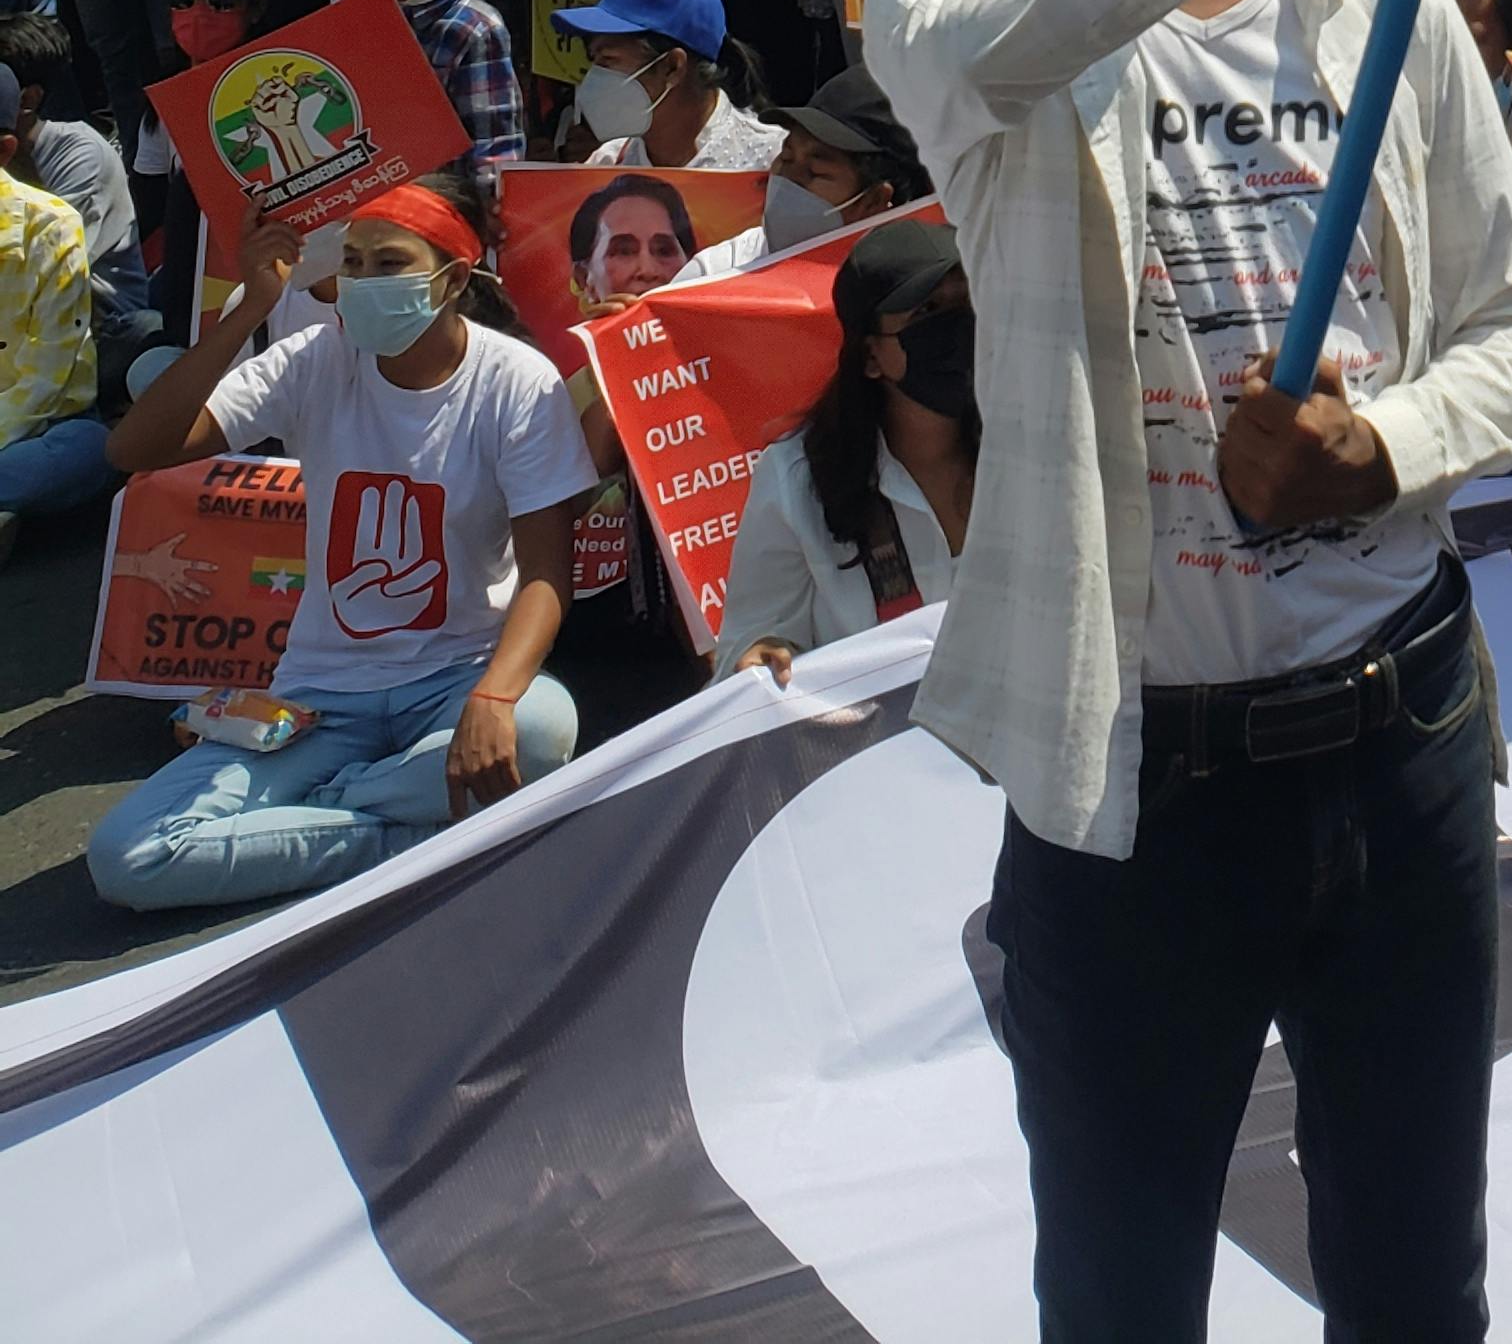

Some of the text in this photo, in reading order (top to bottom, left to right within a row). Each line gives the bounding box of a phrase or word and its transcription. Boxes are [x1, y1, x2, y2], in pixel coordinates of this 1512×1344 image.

[1152, 99, 1345, 161] prem
[287, 148, 367, 196] DISOBEDIENCE
[622, 318, 667, 350] WE
[632, 357, 712, 401] WANT
[645, 415, 706, 452] OUR
[197, 494, 255, 519] SAVE
[588, 512, 625, 529] Our
[574, 537, 625, 553] Need
[668, 512, 739, 558] FREE
[1176, 550, 1228, 577] may
[146, 613, 255, 650] STOP
[139, 656, 250, 681] AGAINST
